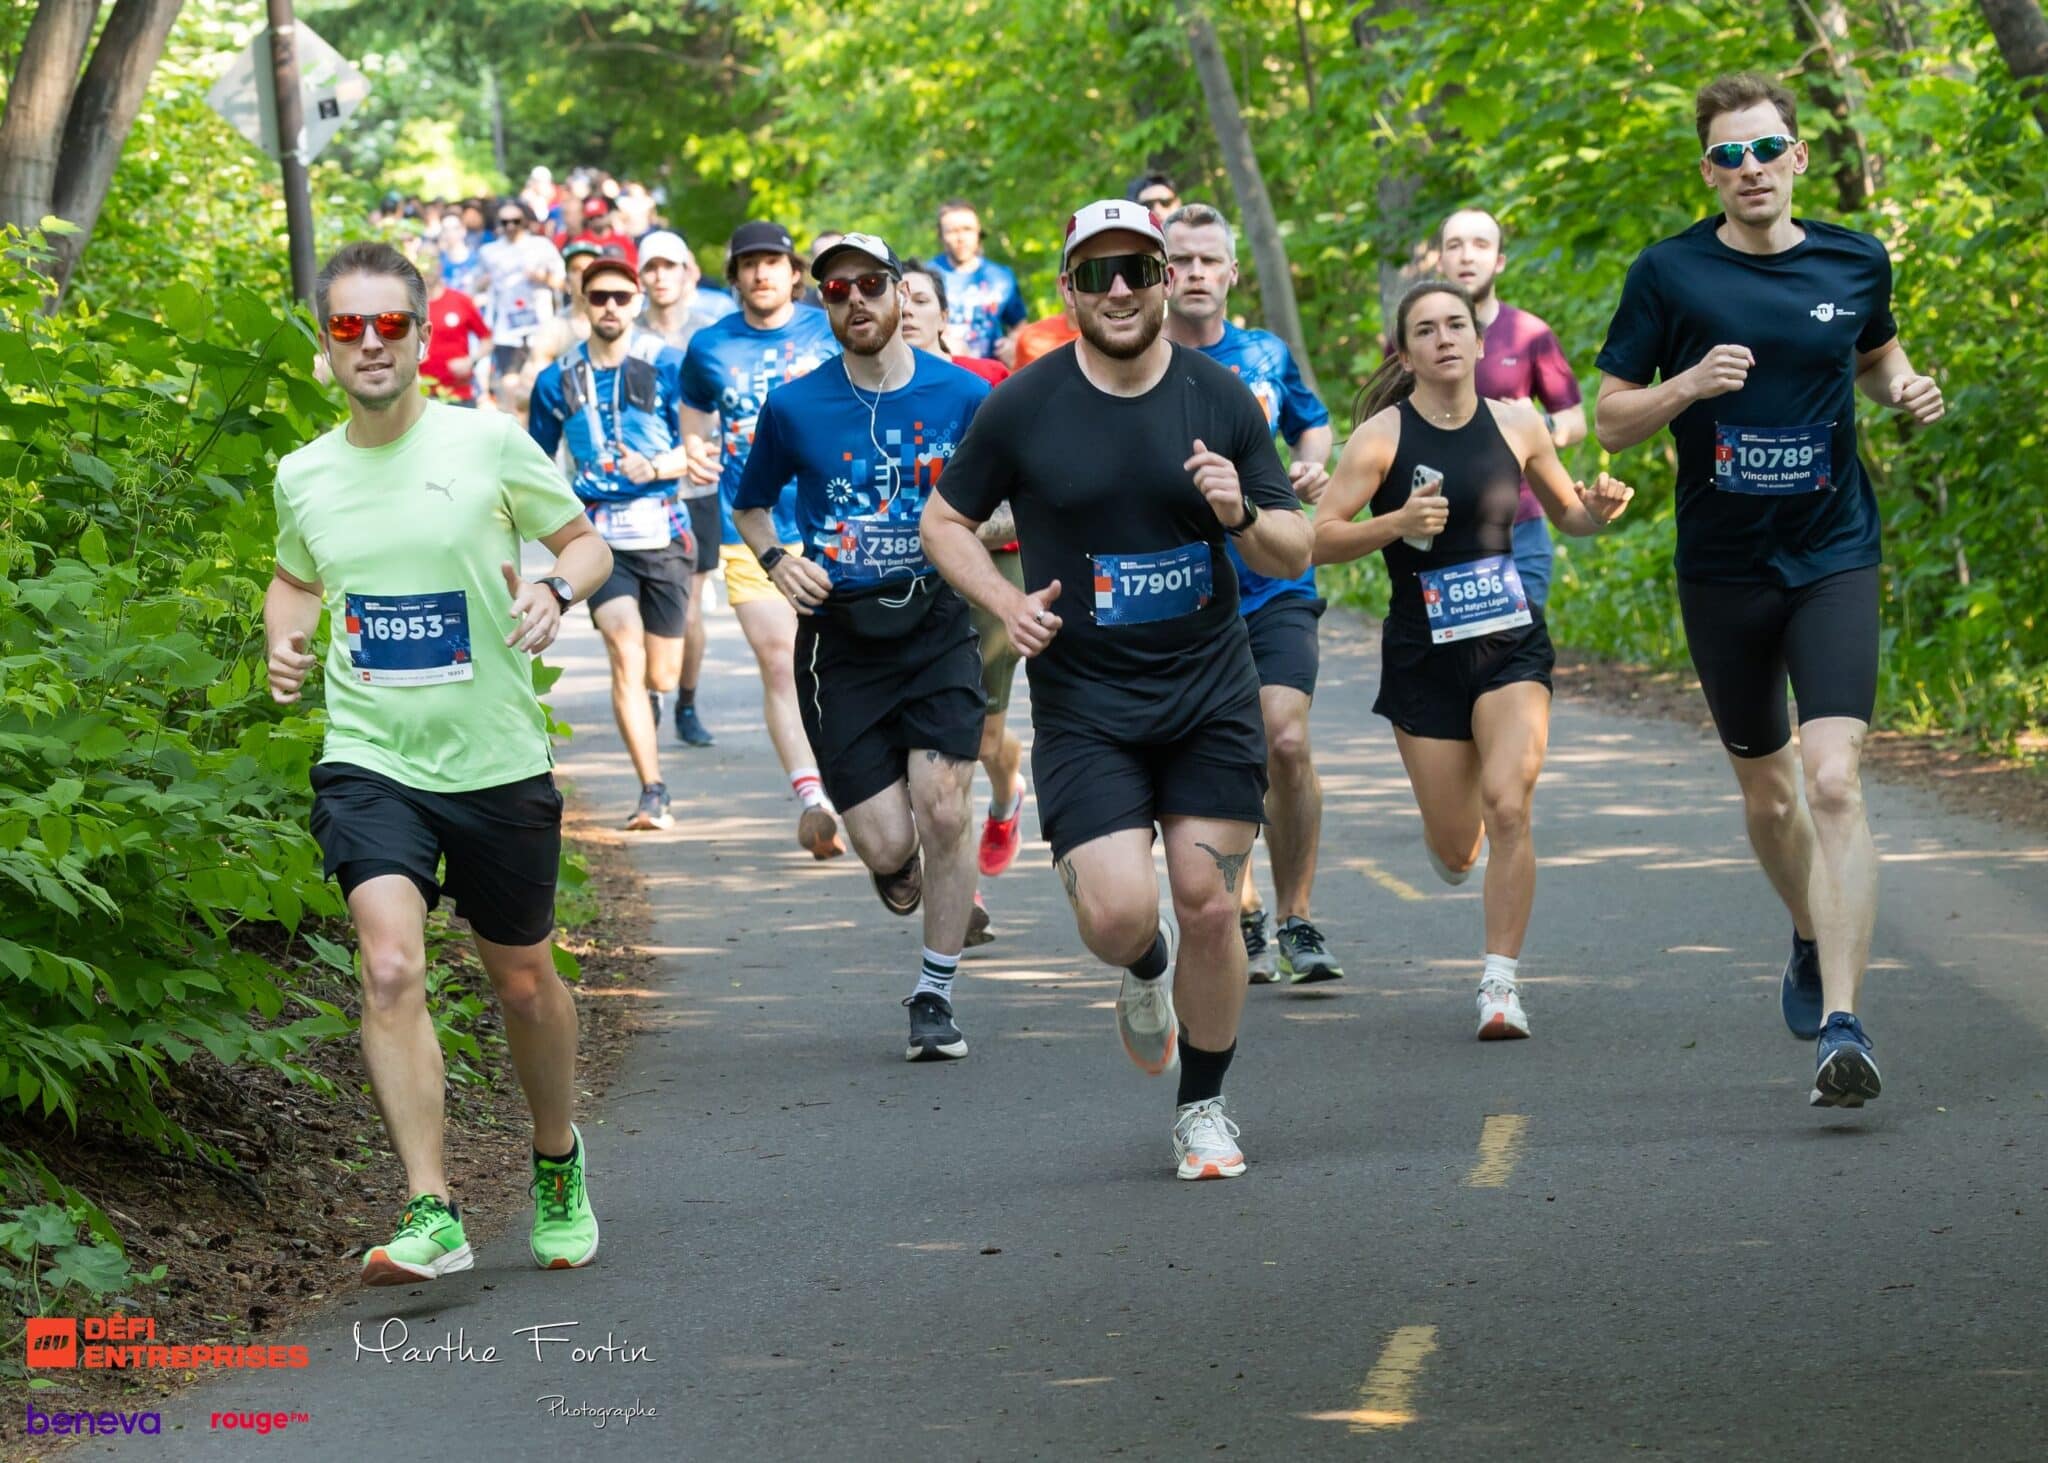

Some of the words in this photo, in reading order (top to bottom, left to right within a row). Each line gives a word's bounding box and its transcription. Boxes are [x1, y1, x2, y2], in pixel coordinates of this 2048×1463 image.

[1737, 446, 1813, 469] 10789
[1741, 471, 1778, 481] Vincent
[1781, 471, 1811, 481] Nahon
[867, 536, 921, 556] 7389
[1120, 566, 1192, 597] 17901
[1448, 575, 1504, 602] 6896
[364, 614, 444, 641] 16953
